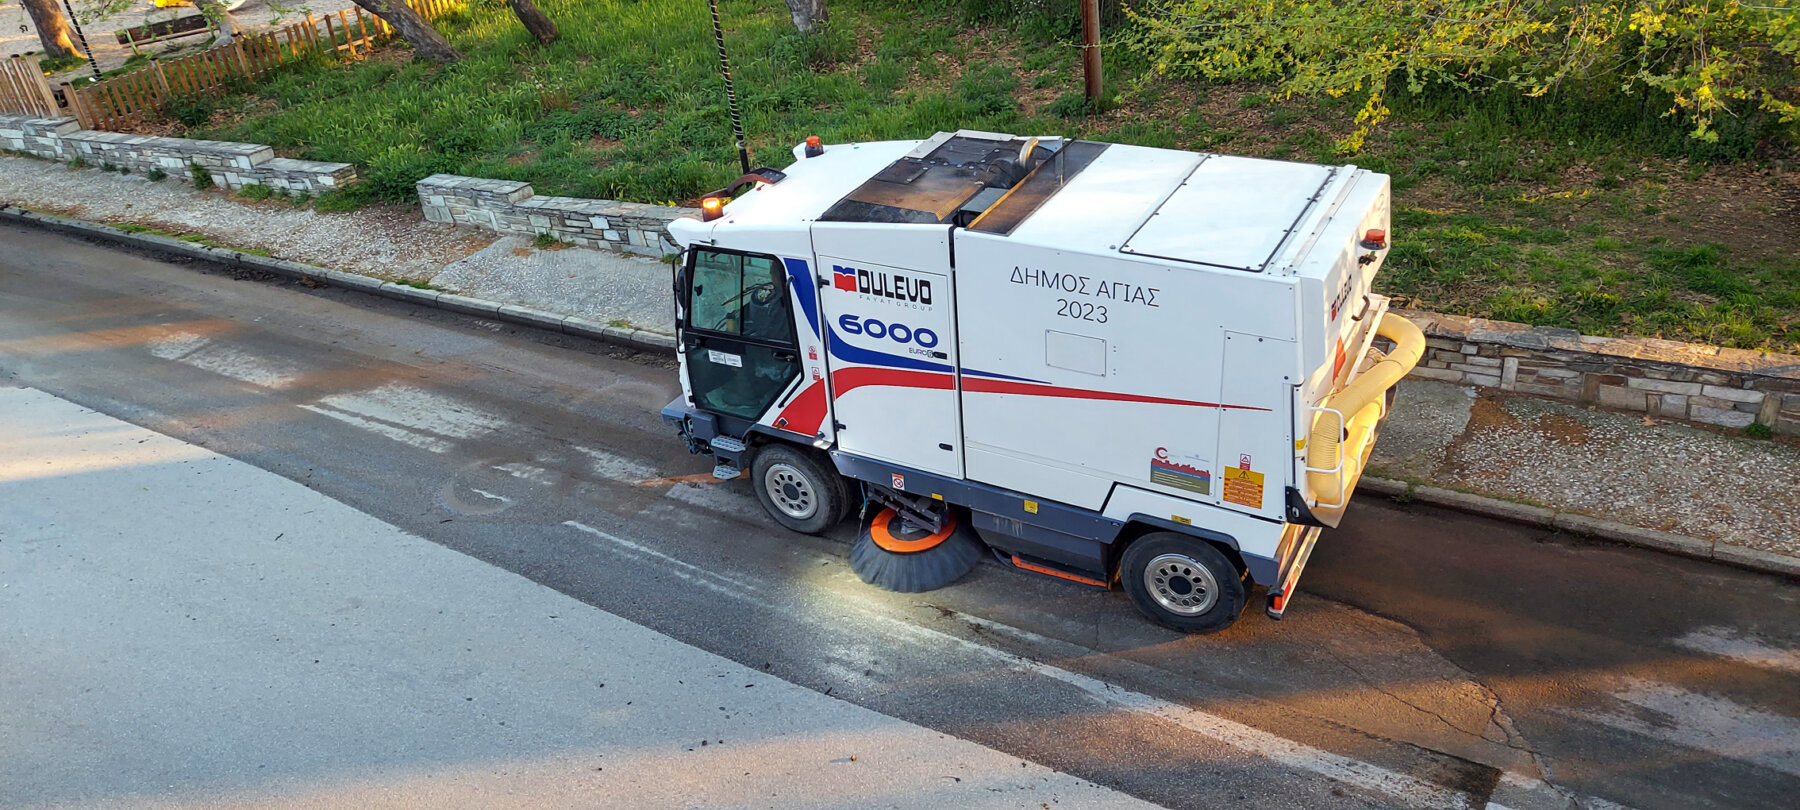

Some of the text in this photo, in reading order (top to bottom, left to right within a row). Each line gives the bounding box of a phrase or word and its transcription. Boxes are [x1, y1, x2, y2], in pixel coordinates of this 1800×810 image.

[857, 268, 932, 306] DULEVO
[859, 294, 933, 312] FAYAT GROUP
[1010, 265, 1160, 308] ΔΗΜΟΣ ΑΓΙΑΣ
[1056, 298, 1109, 324] 2023
[838, 313, 939, 349] 6000
